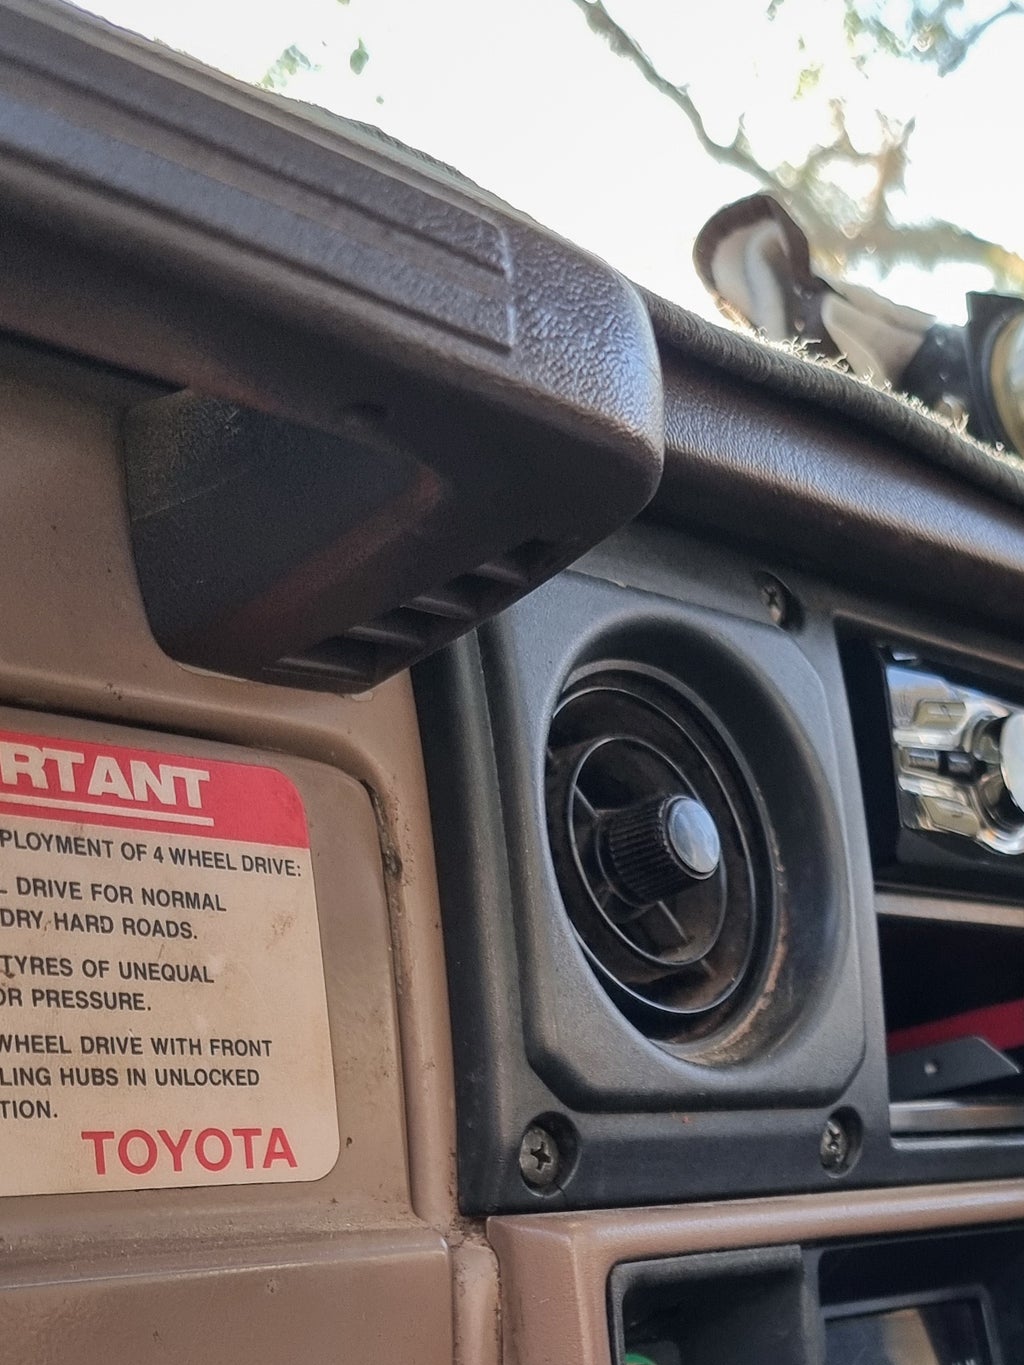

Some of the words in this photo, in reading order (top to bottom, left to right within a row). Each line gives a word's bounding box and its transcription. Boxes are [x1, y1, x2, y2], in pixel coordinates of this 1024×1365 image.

[0, 741, 210, 809] RTANT
[0, 829, 113, 858] PLOYMENT
[121, 841, 147, 861] OF
[153, 845, 164, 863] 4
[169, 847, 237, 871] WHEEL
[242, 855, 301, 877] DRIVE:
[16, 876, 83, 900] DRIVE
[91, 883, 134, 904] FOR
[142, 888, 227, 912] NORMAL
[54, 912, 114, 934] HARD
[122, 917, 198, 939] ROADS.
[0, 955, 73, 977] TYRES
[82, 959, 109, 978] OF
[119, 961, 214, 983] UNEQUAL
[32, 988, 151, 1011] PRESSURE.
[0, 1034, 72, 1054] WHEEL
[80, 1035, 143, 1055] DRIVE
[150, 1037, 202, 1055] WITH
[210, 1039, 272, 1057] FRONT
[0, 1067, 51, 1086] LING
[60, 1067, 118, 1086] HUBS
[127, 1068, 146, 1086] IN
[155, 1068, 260, 1086] UNLOCKED
[0, 1100, 57, 1119] TION.
[81, 1127, 297, 1175] TOYOTA
